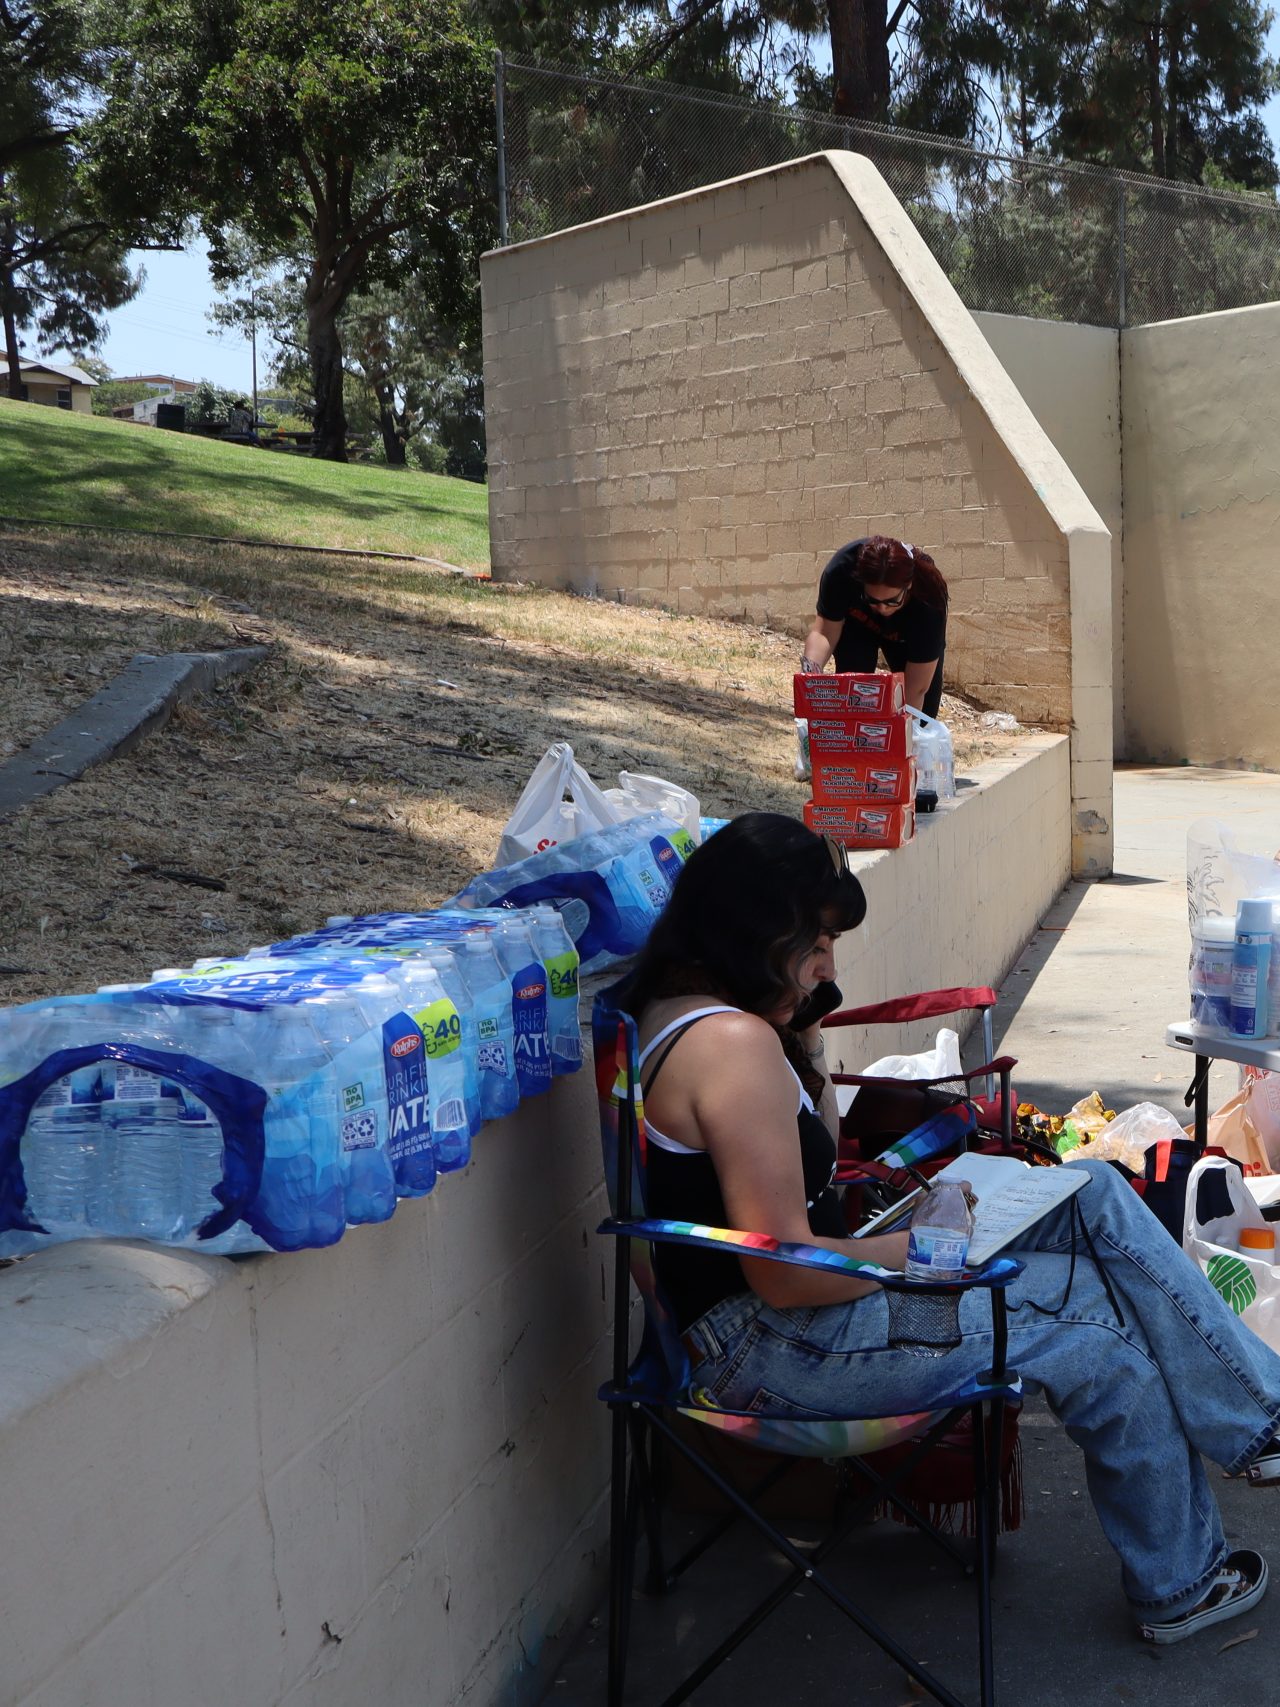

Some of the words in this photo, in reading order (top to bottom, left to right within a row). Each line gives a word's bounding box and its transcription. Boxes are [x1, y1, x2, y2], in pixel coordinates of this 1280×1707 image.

[849, 696, 861, 706] 12
[855, 737, 867, 747] 12
[866, 783, 879, 793] 12
[856, 823, 867, 833] 12
[434, 1014, 460, 1038] 40
[346, 1086, 358, 1096] no
[345, 1094, 362, 1106] BPA
